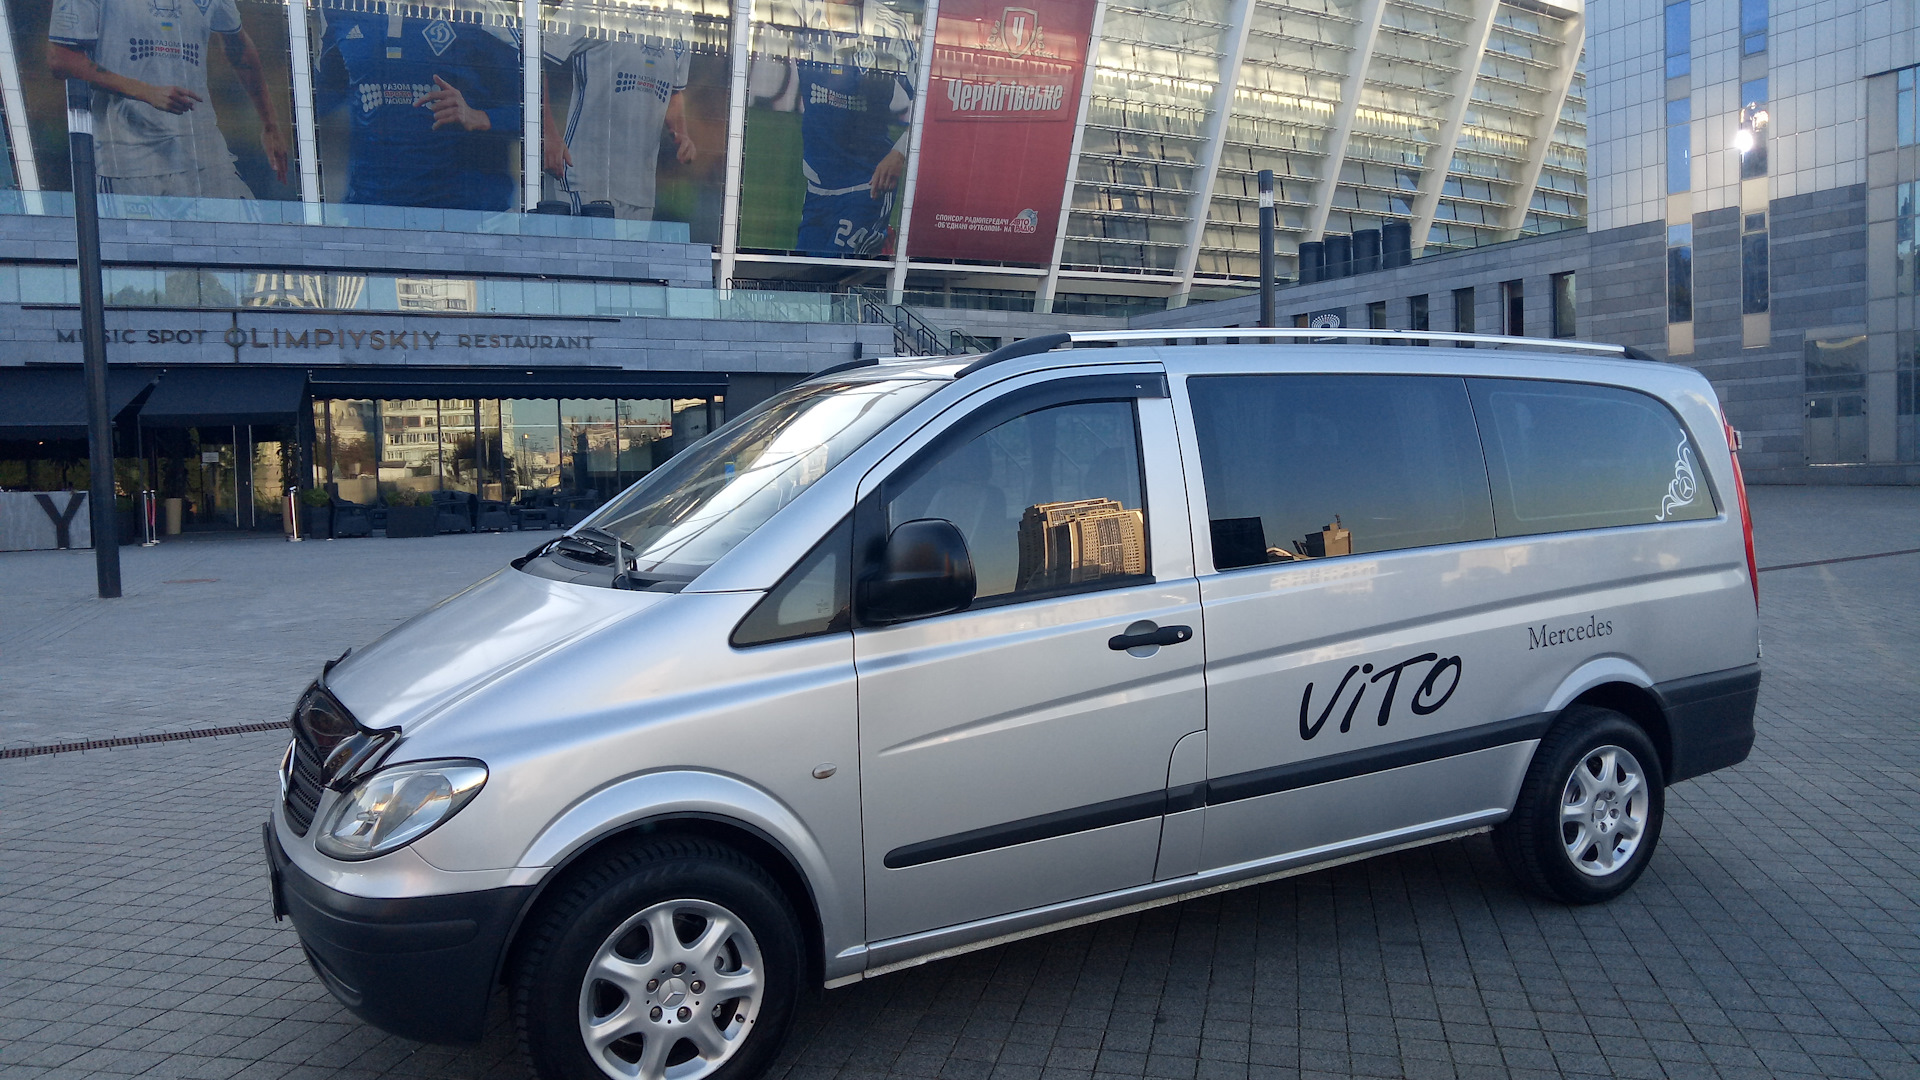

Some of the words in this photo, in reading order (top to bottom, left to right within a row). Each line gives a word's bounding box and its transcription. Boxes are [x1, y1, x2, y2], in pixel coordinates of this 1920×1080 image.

[154, 46, 181, 54] ПРОТИ
[382, 83, 411, 91] РАЗОМ
[935, 213, 964, 223] СПОНСОР
[57, 328, 136, 344] MIC
[146, 329, 208, 345] SPOT
[224, 327, 441, 351] OLIMPIYSKIY
[458, 333, 596, 350] RESTAURANT
[1528, 615, 1613, 651] Mercedes
